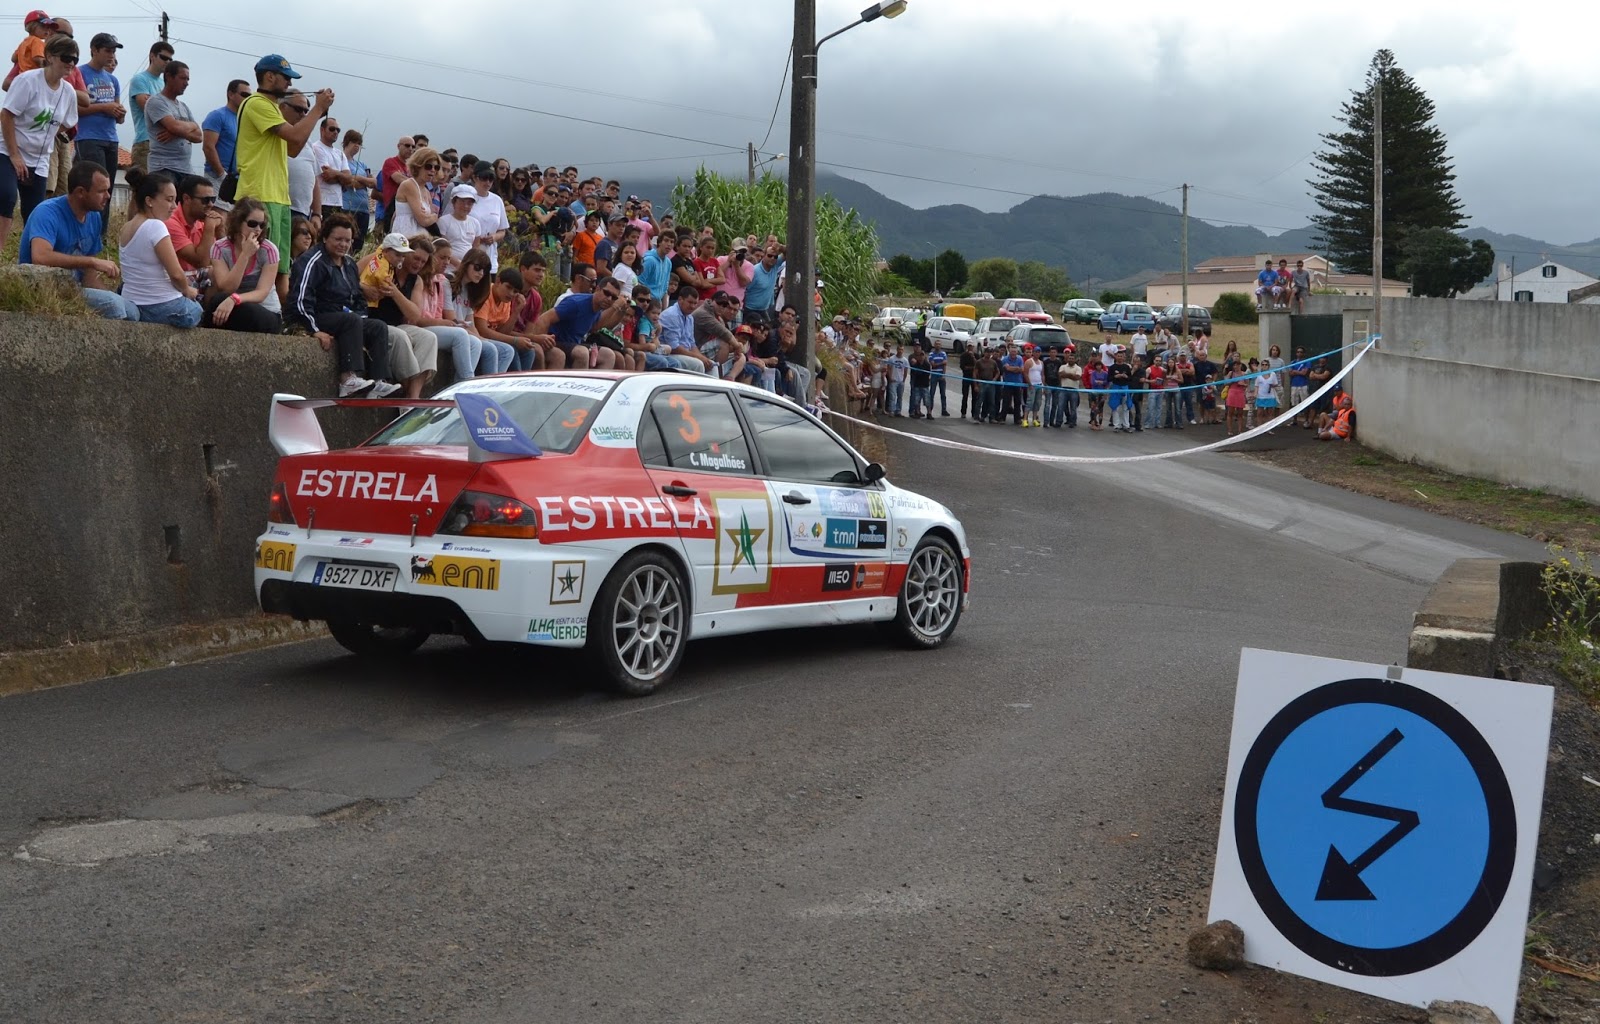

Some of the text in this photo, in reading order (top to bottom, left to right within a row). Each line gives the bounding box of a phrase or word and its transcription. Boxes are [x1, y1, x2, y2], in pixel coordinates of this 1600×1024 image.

[557, 381, 608, 394] Estrela
[561, 408, 589, 428] 3
[668, 394, 701, 444] 3
[610, 431, 634, 440] VERDE
[690, 452, 746, 470] C. Magalhães
[296, 469, 439, 503] ESTRELA
[536, 496, 713, 531] ESTRELA
[868, 493, 885, 518] 03
[833, 528, 855, 545] tmn
[264, 543, 295, 572] eni
[324, 567, 394, 588] 9527 DXF
[441, 559, 496, 590] eni
[828, 570, 850, 584] MEO
[528, 619, 555, 632] ILHA
[551, 626, 587, 640] VERDE
